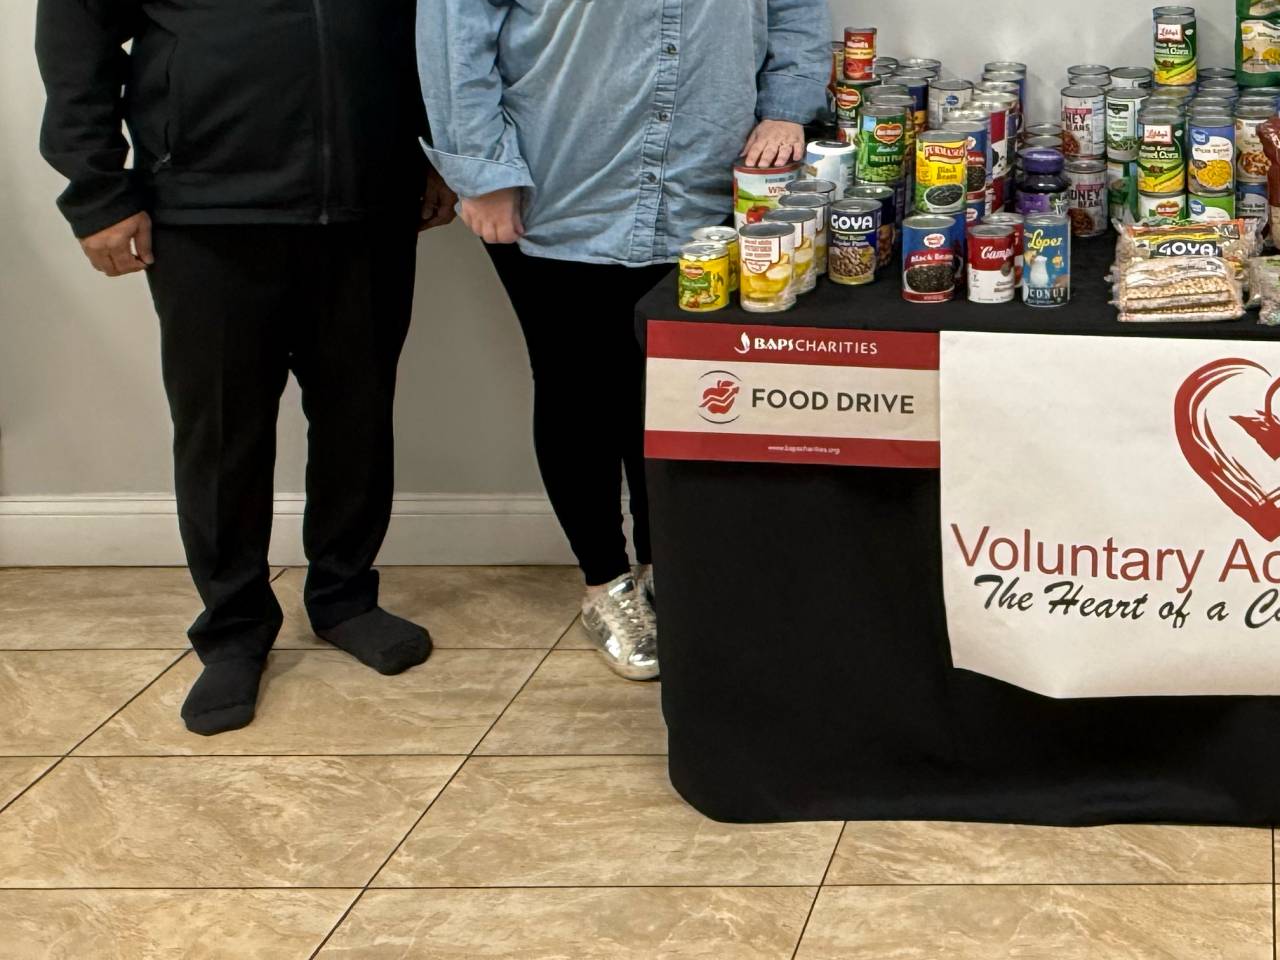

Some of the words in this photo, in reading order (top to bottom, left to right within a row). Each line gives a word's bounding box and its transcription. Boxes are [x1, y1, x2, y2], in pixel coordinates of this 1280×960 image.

[831, 214, 873, 230] GOYA
[1027, 228, 1063, 253] Lopez
[1157, 242, 1214, 256] GOYA
[910, 253, 933, 263] Black
[751, 388, 829, 411] FOOD
[836, 392, 915, 414] DRIVE
[767, 444, 841, 455] www.bapscharities.org
[950, 523, 1205, 594] Voluntary
[973, 573, 1034, 613] The
[1043, 577, 1149, 621] Heart
[1158, 589, 1191, 629] of
[1206, 600, 1229, 621] a
